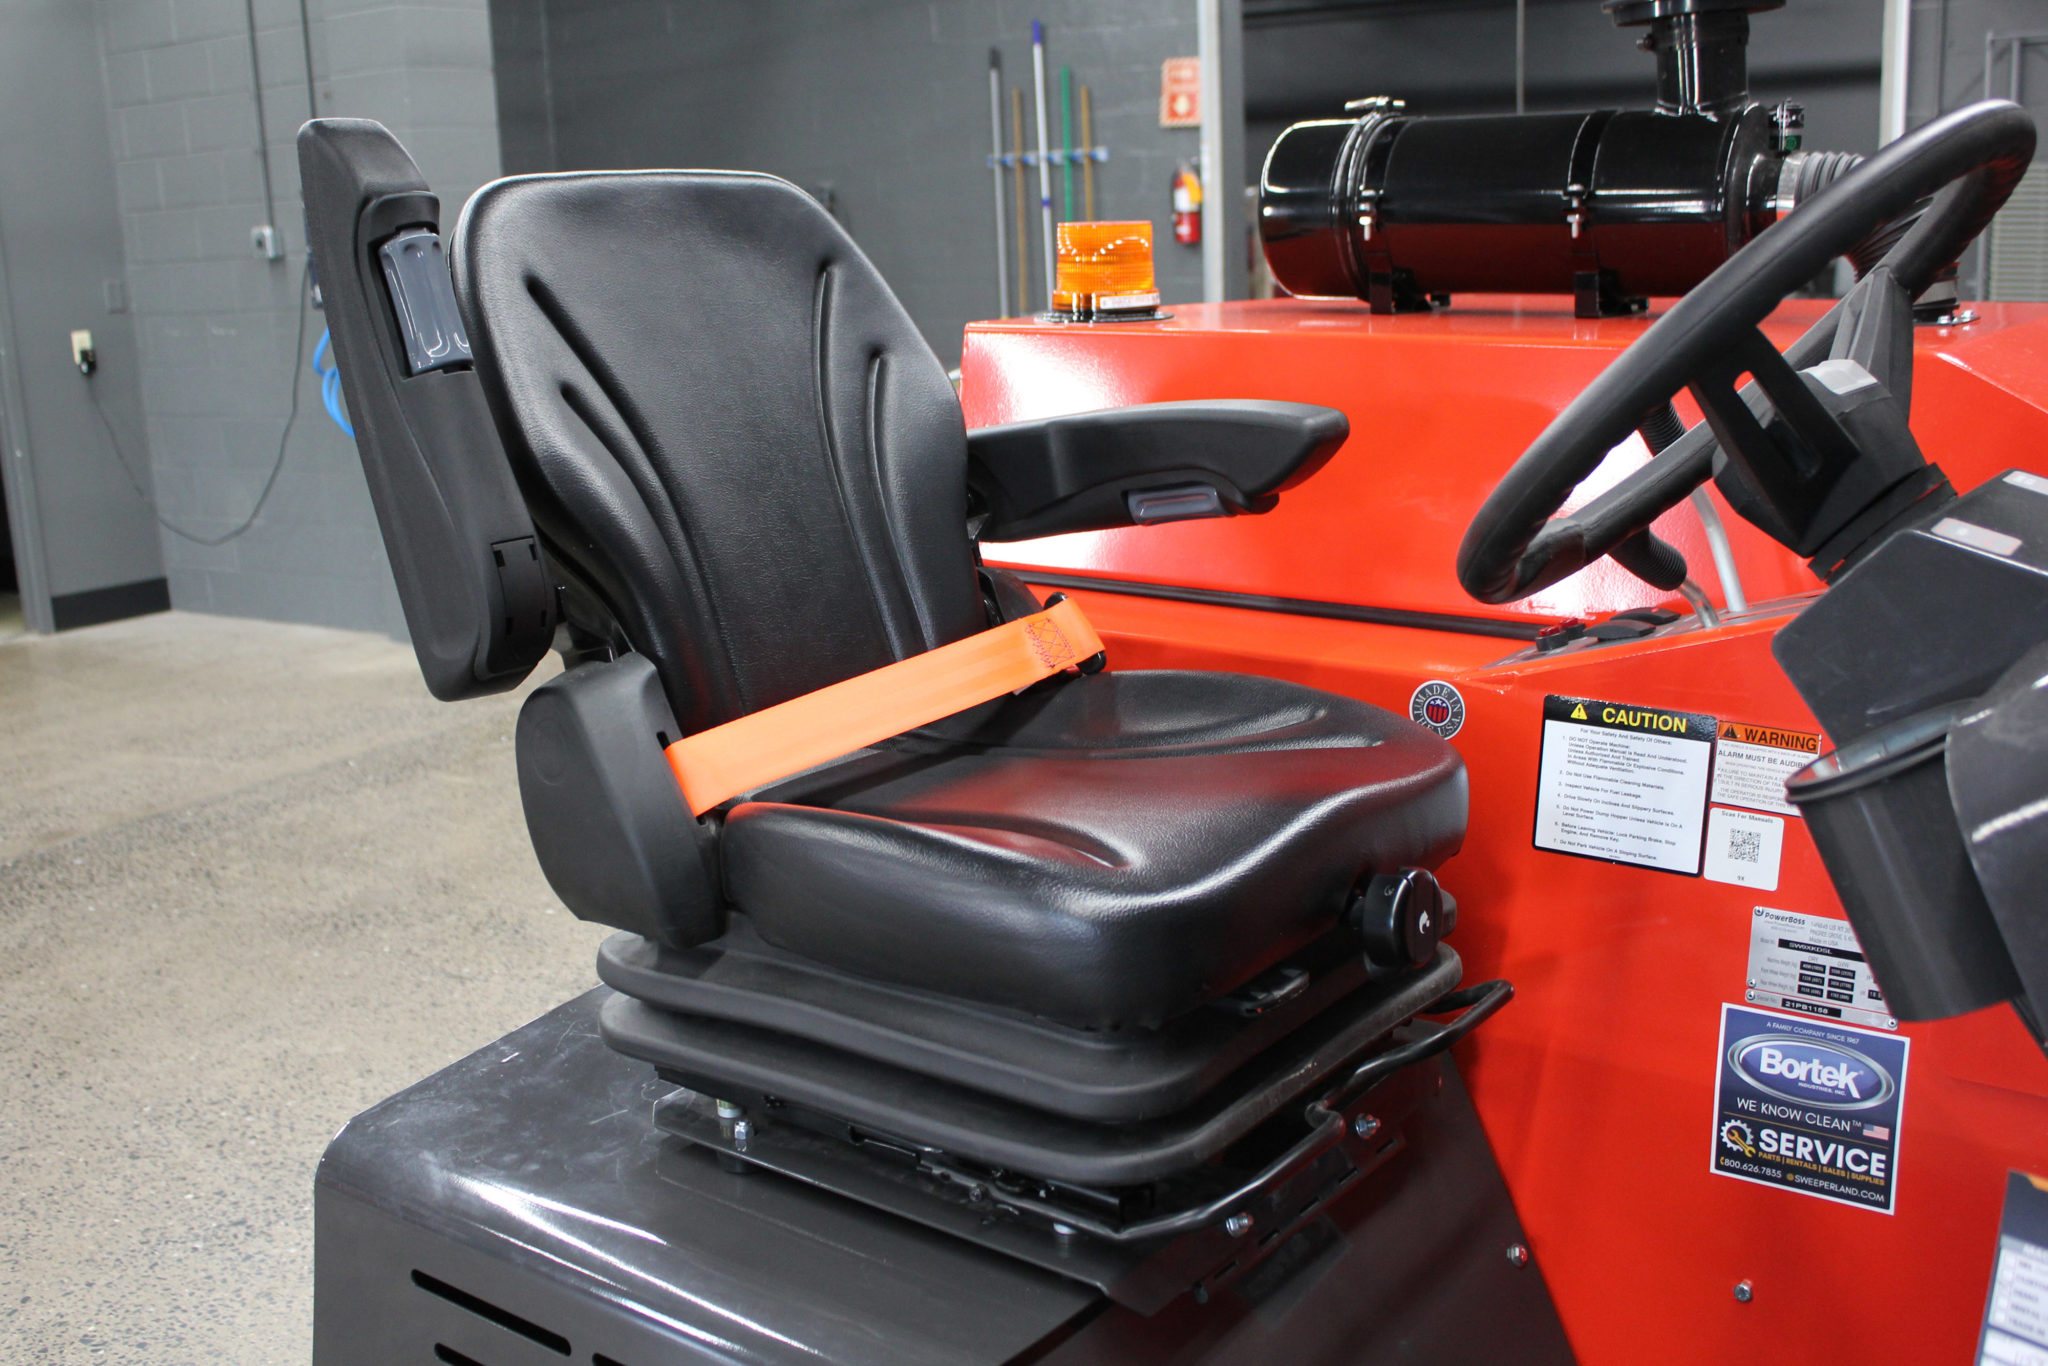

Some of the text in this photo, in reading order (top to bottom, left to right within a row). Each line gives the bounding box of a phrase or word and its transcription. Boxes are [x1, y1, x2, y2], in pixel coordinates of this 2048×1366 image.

[1601, 707, 1687, 733] CAUTION
[1743, 727, 1818, 750] WARNING
[1718, 749, 1743, 758] ALARM
[1745, 753, 1765, 762] MUST
[1767, 756, 1777, 764] BE
[1748, 815, 1773, 823] Manuals
[1764, 912, 1805, 925] PowerBoss
[1772, 1022, 1792, 1031] FAMILY
[1793, 1026, 1824, 1038] COMPANY
[1826, 1032, 1845, 1042] SINCE
[1736, 1096, 1757, 1112] WE
[1760, 1102, 1801, 1121] KNOW
[1758, 1126, 1886, 1178] SERVICE
[1724, 1157, 1884, 1203] 800.626.7835 SWEEPERLAND.COM
[1758, 1151, 1884, 1186] PARTS RENTALS SALES SUPPLIES
